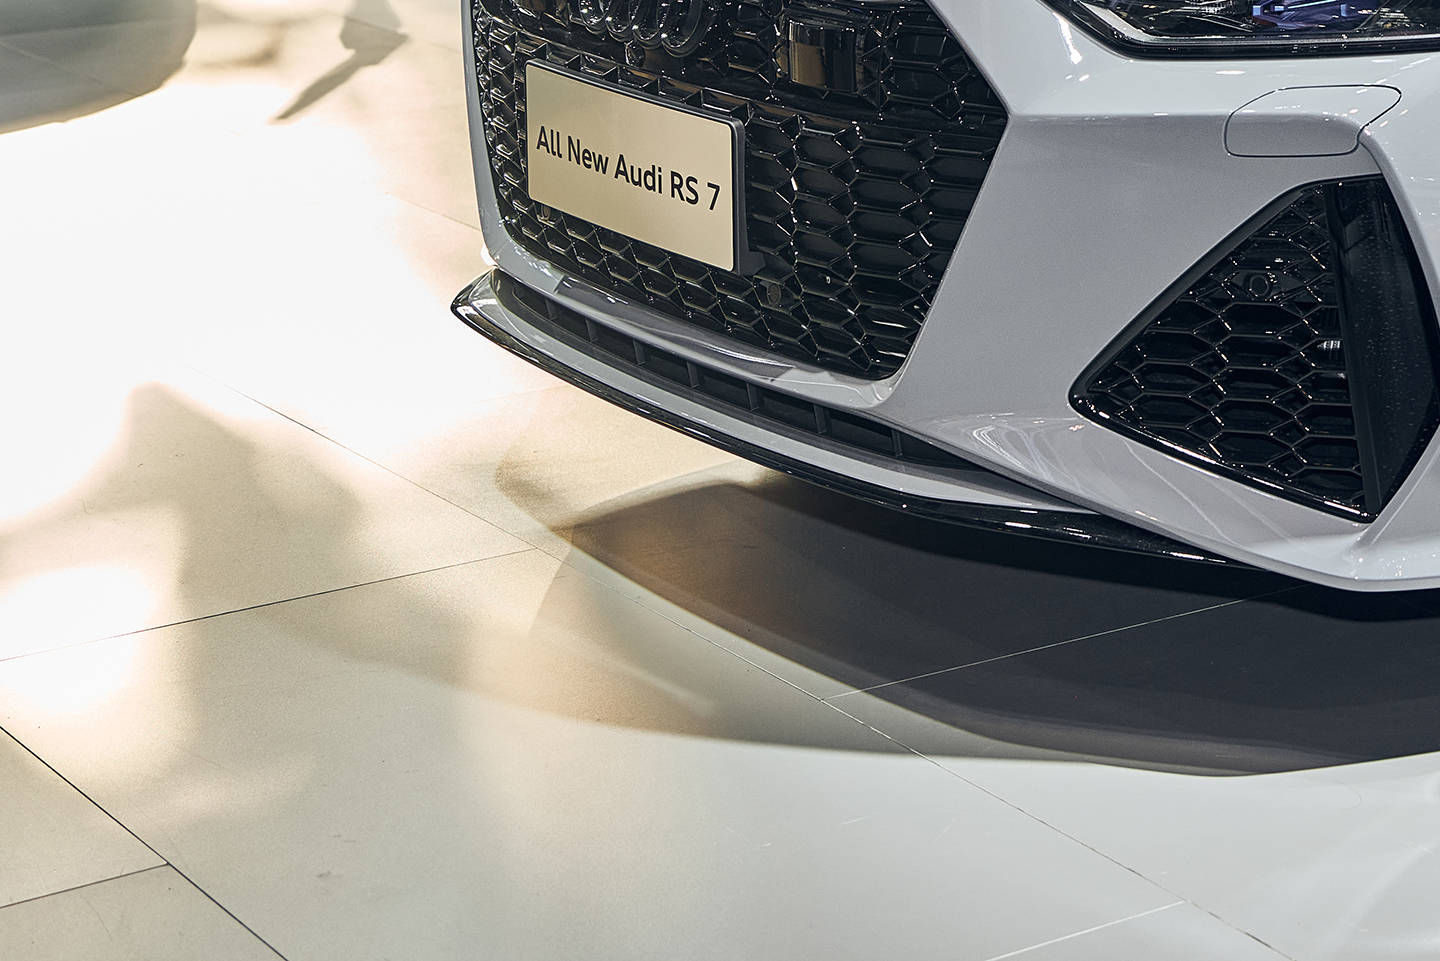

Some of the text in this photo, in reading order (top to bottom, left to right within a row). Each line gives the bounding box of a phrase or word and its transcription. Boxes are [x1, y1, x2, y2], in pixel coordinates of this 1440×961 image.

[536, 126, 721, 210] All New Audi RS 7
